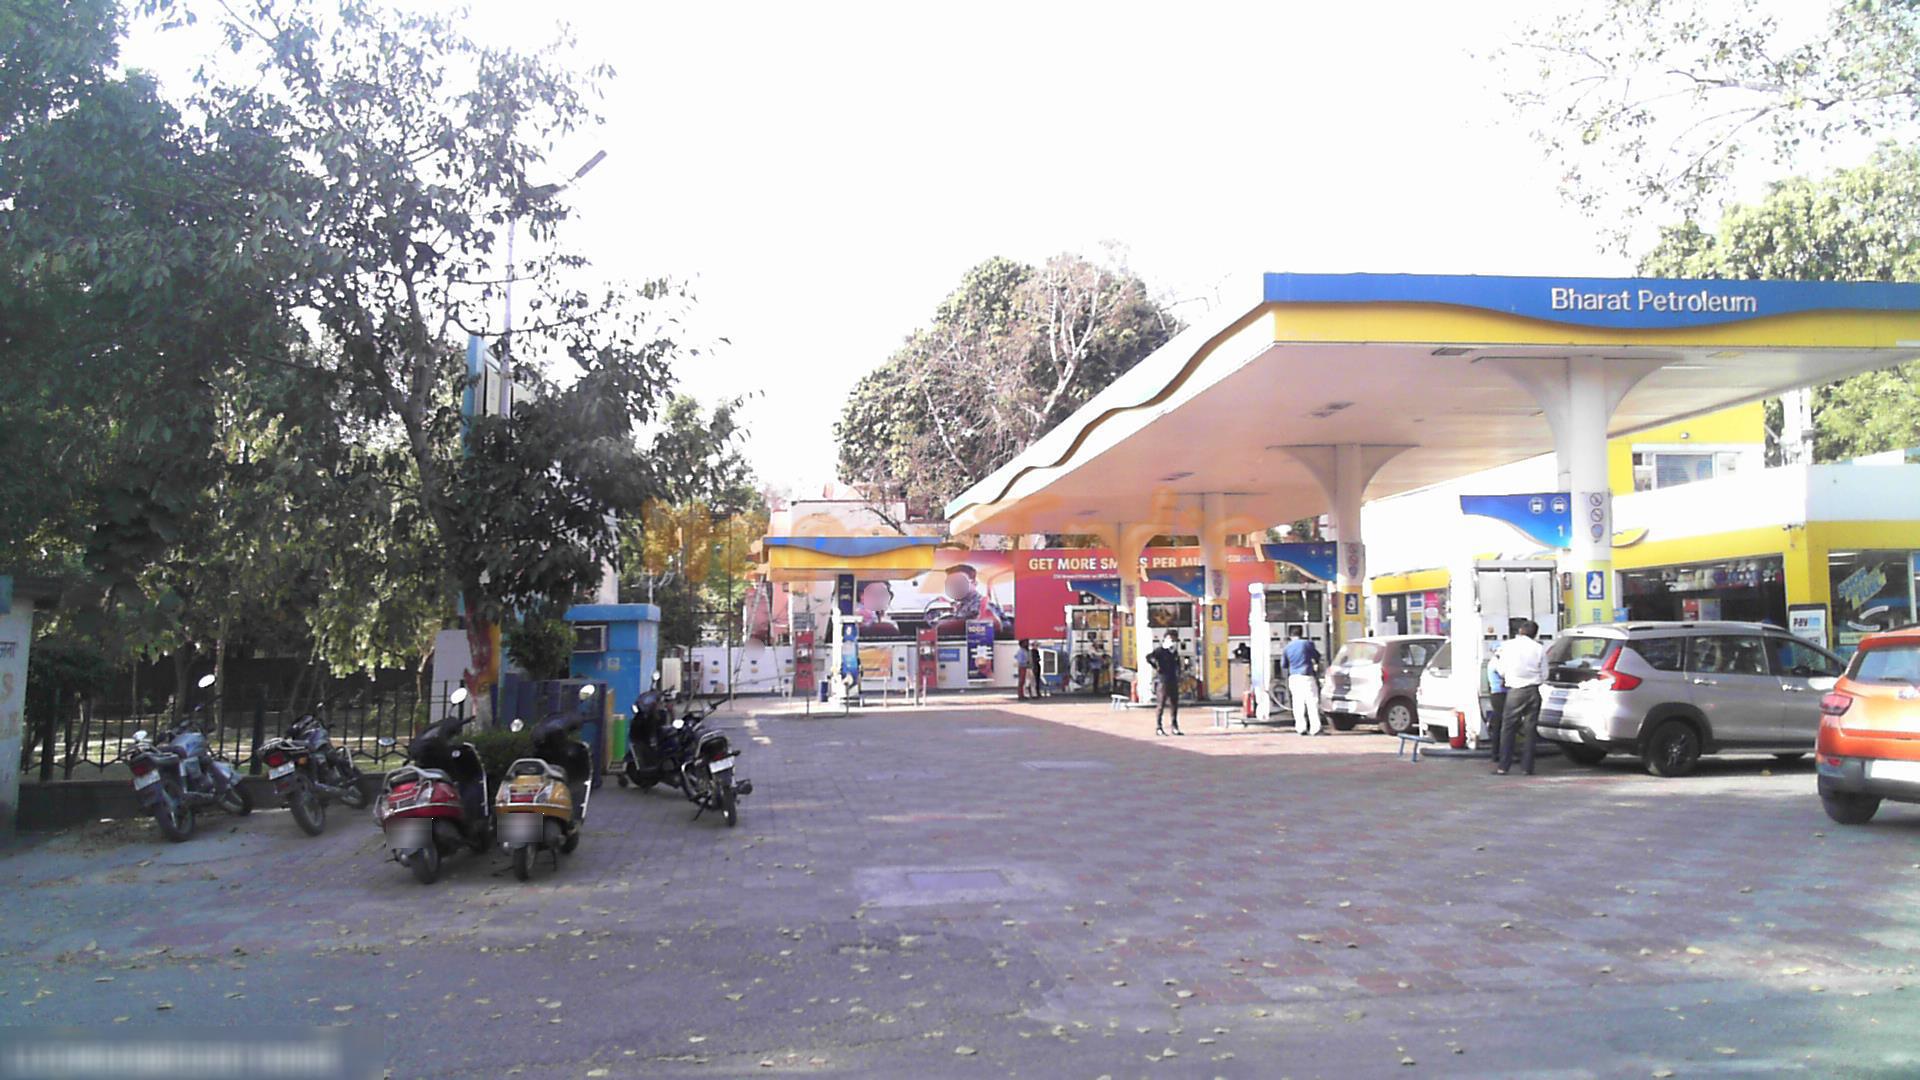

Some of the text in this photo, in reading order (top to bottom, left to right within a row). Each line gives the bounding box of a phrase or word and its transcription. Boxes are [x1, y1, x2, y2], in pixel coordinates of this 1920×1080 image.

[1551, 287, 1757, 313] Bharat Petroleum
[1557, 525, 1564, 537] 1
[1029, 558, 1054, 570] GET
[1057, 558, 1097, 570] MORE
[1153, 557, 1177, 569] PER
